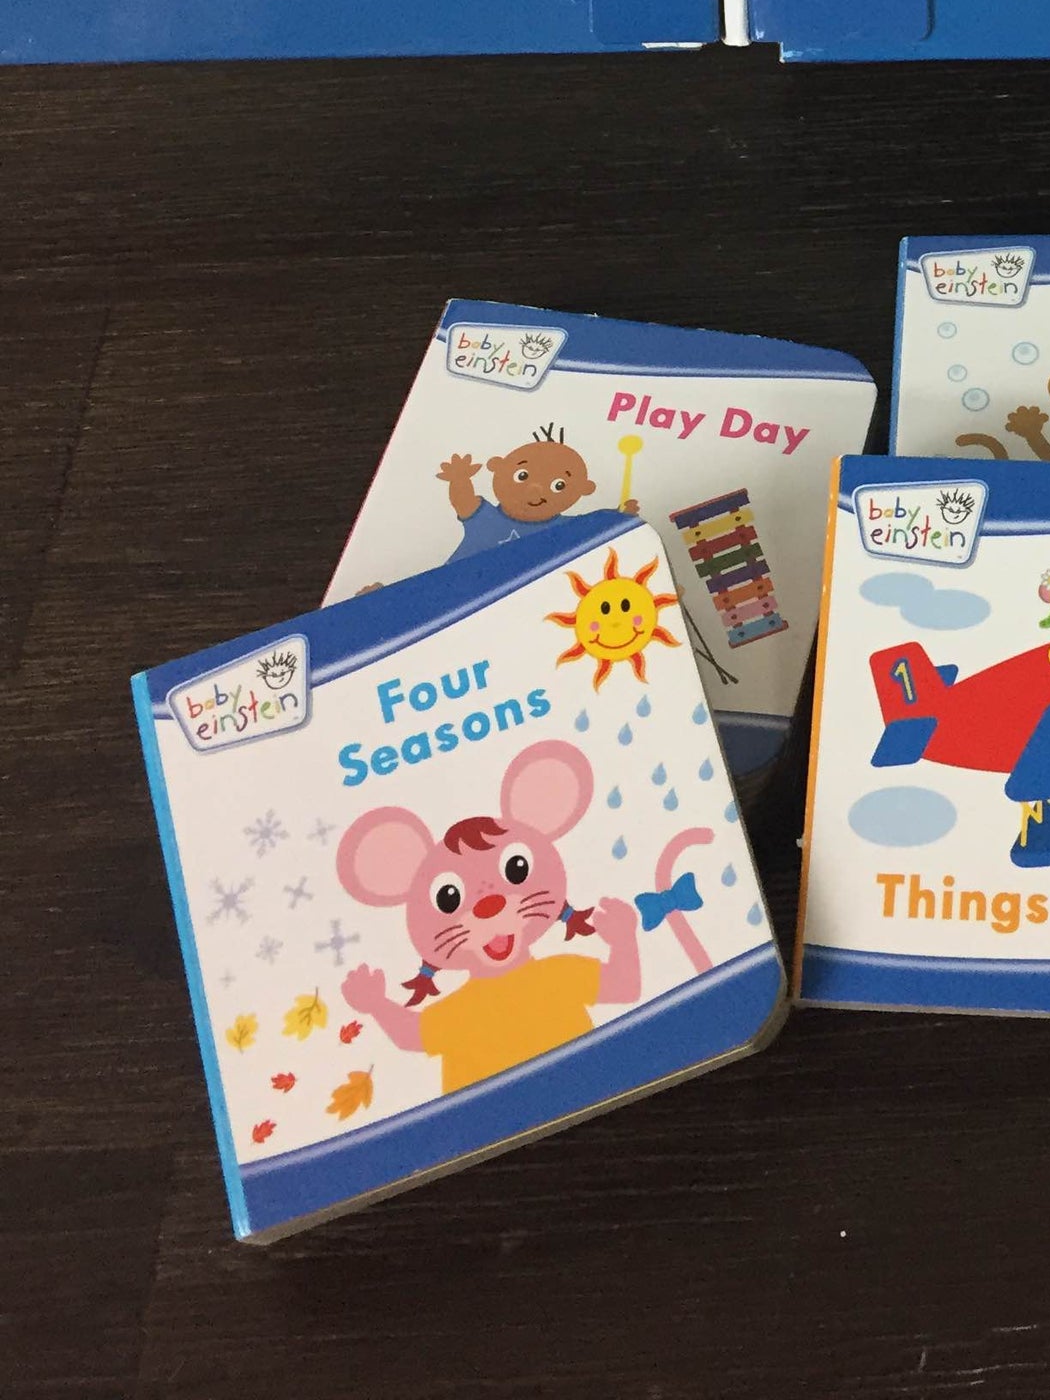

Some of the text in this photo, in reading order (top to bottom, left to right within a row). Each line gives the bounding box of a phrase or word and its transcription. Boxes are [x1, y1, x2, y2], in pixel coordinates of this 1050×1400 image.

[933, 261, 979, 284] baby
[935, 273, 1019, 299] einstein
[454, 349, 538, 378] einstein
[457, 332, 506, 359] baby
[606, 392, 811, 455] Play Day
[868, 498, 920, 528] baby
[869, 518, 966, 552] einstein
[376, 658, 491, 724] Four
[890, 659, 917, 703] 1
[186, 683, 243, 719] baby
[195, 690, 299, 741] einstein
[338, 688, 551, 787] Seasons
[875, 873, 1049, 933] Things
